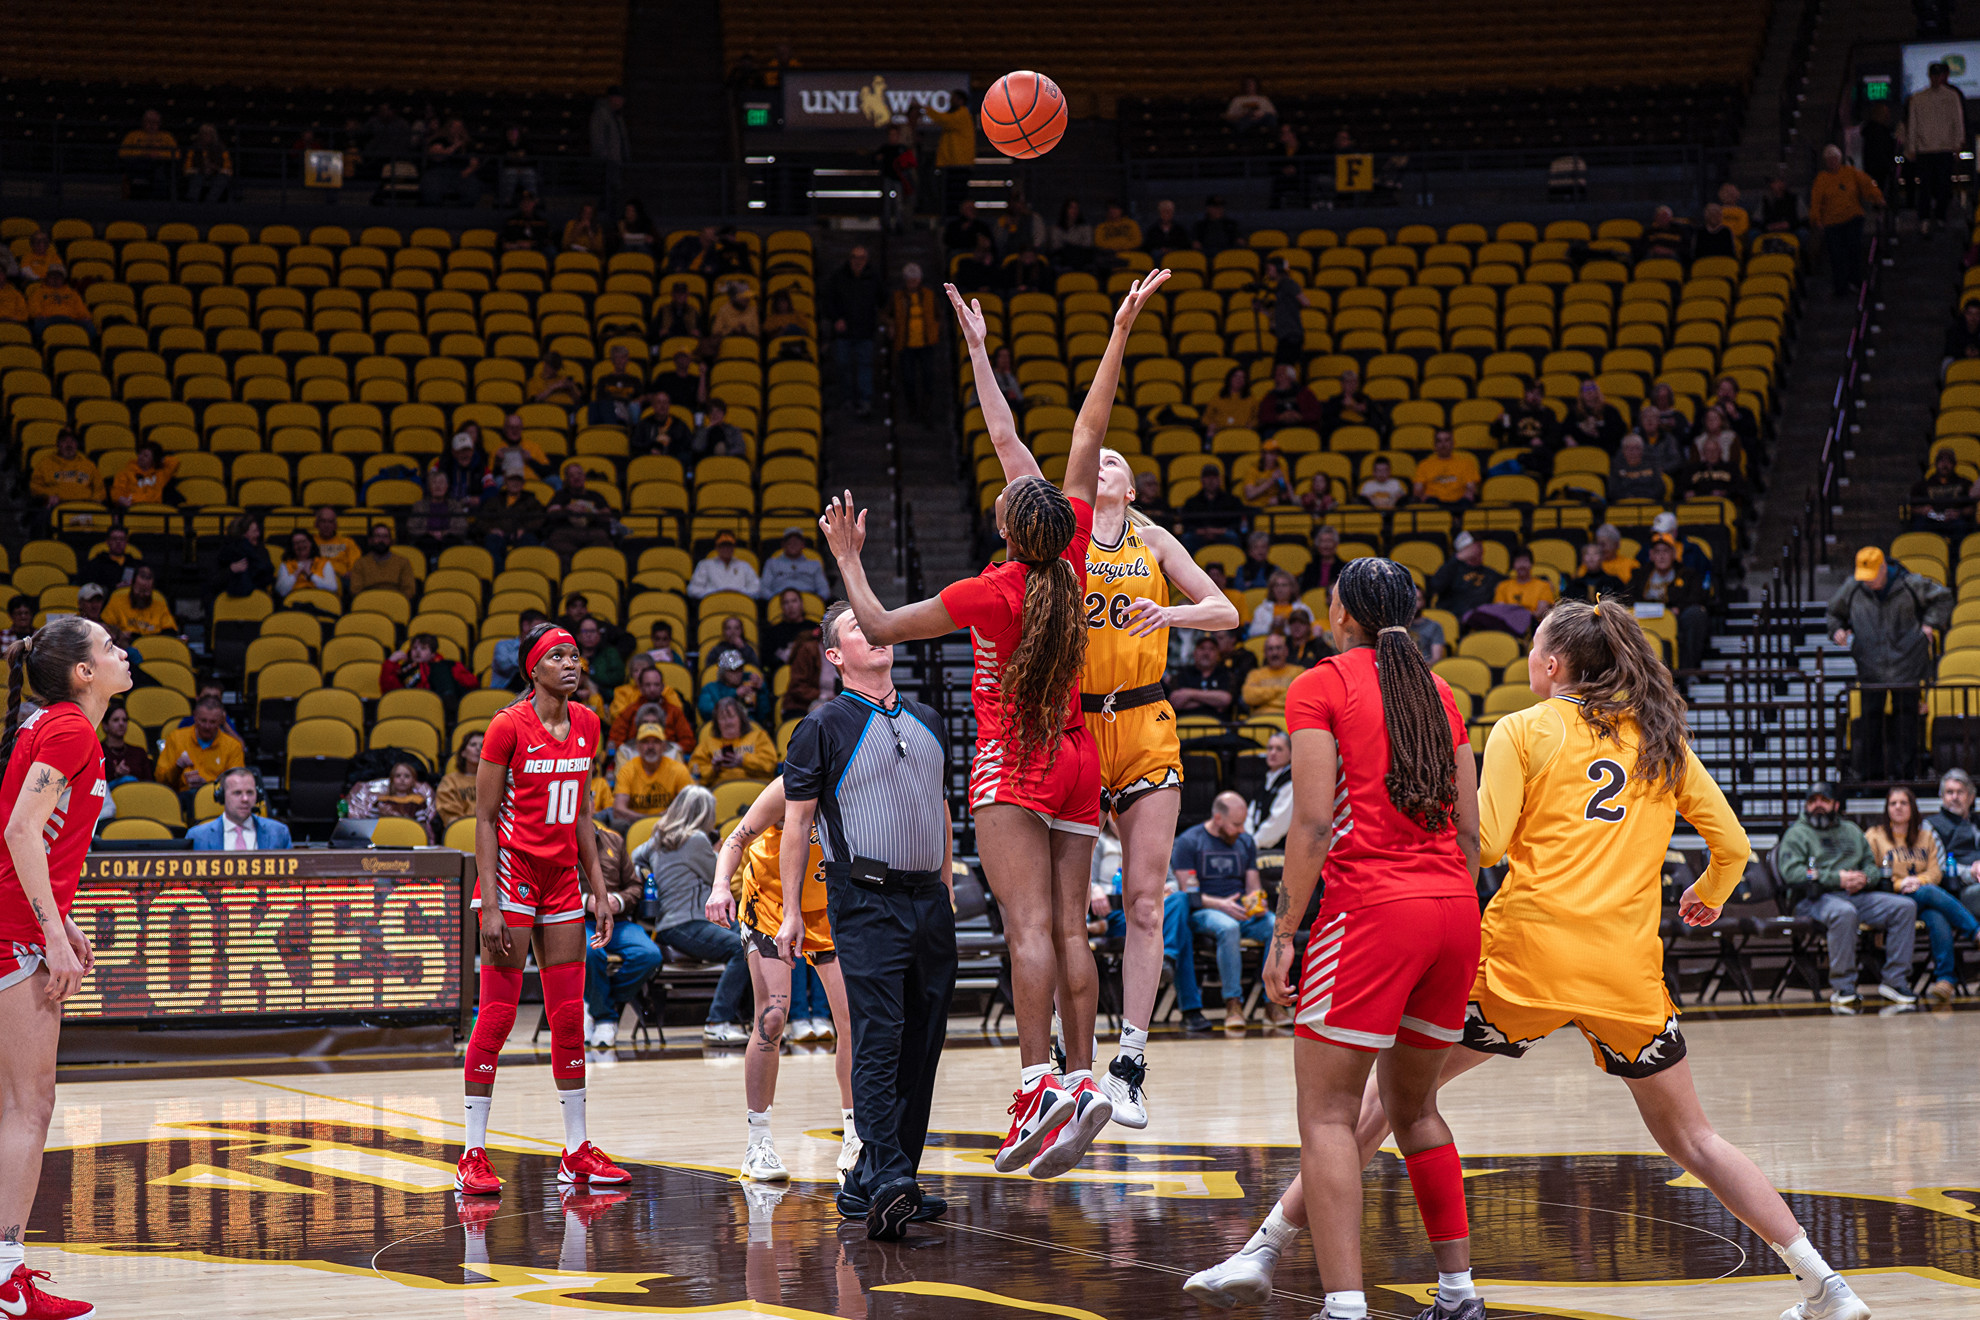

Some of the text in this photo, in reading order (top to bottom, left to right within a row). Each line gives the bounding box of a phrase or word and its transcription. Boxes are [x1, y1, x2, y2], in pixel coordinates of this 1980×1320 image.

[1346, 159, 1363, 187] F
[1085, 553, 1151, 583] owgirls
[1084, 592, 1132, 630] 26
[523, 757, 591, 774] NEW MEXICO
[545, 779, 579, 825] 10
[1584, 758, 1627, 823] 2
[64, 883, 446, 1017] POKES
